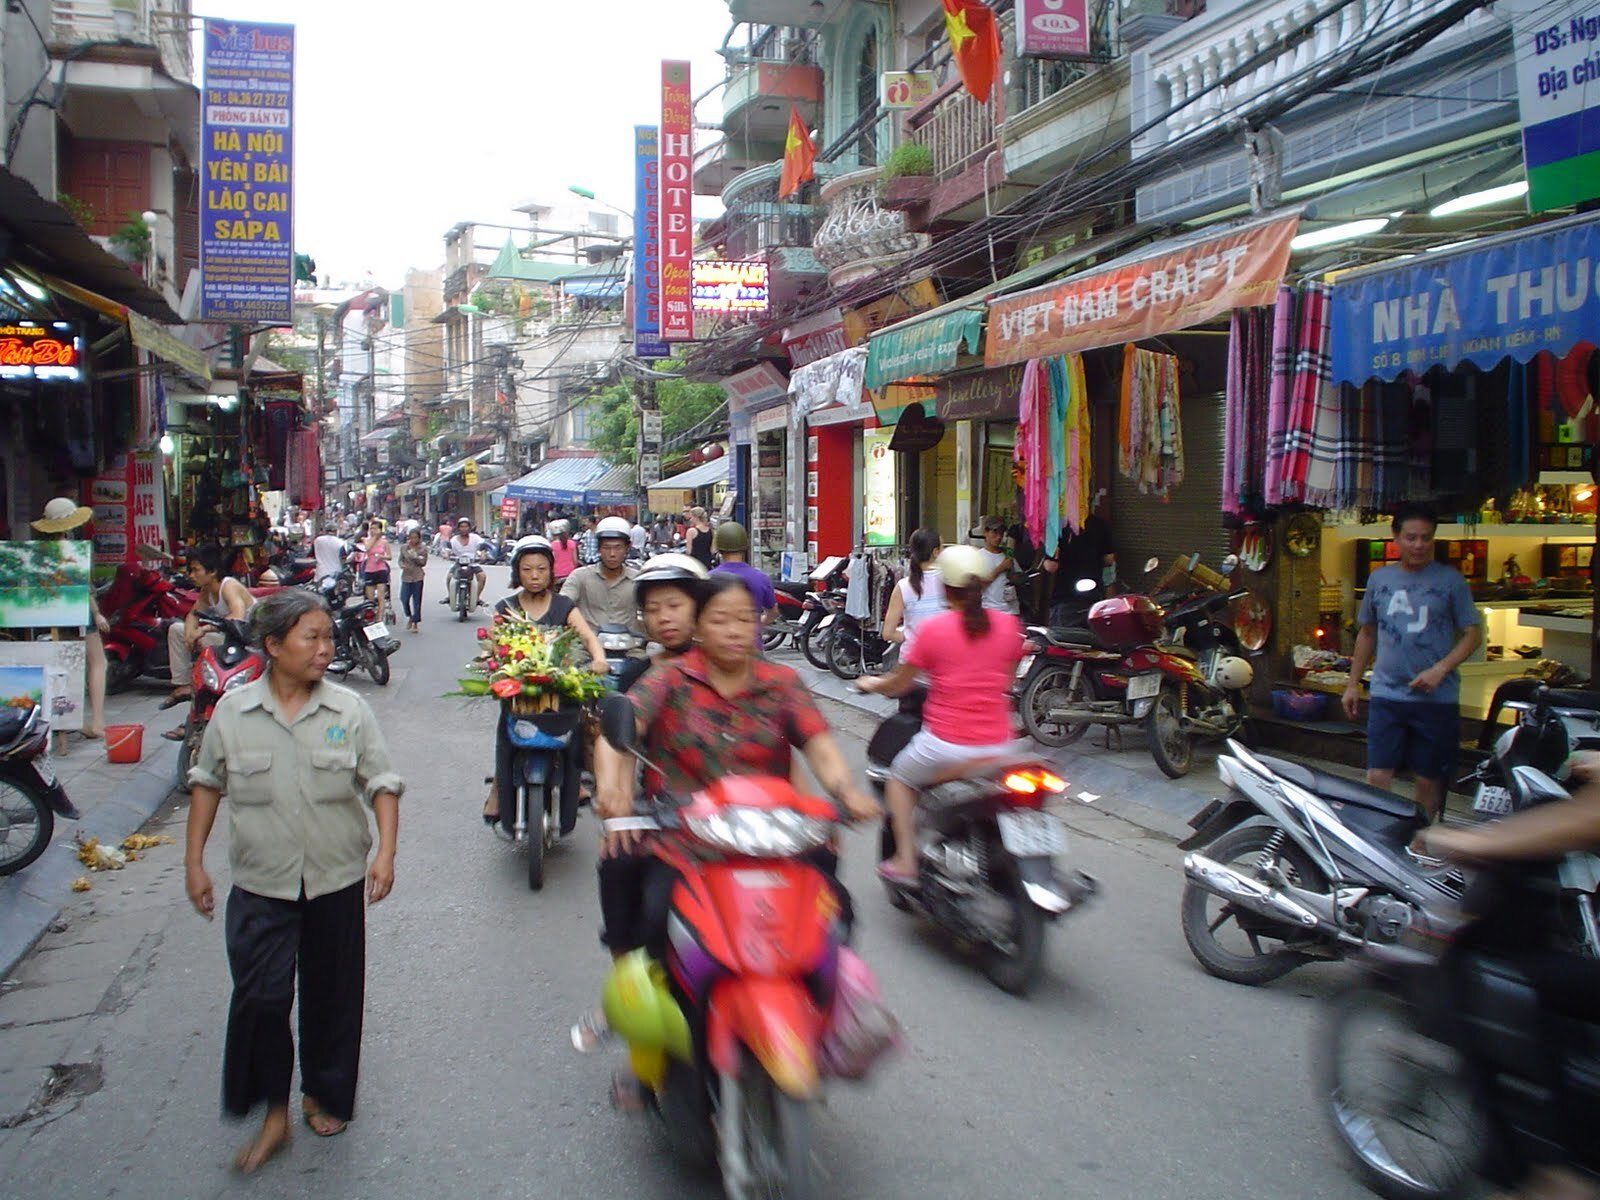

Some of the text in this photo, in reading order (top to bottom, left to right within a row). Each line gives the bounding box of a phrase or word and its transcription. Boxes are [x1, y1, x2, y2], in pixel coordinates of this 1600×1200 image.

[1570, 15, 1600, 43] Ng
[1538, 66, 1568, 100] Địa
[213, 128, 283, 157] HÀ NỘI
[207, 157, 288, 182] YÊN BÁI
[208, 186, 287, 211] LÀO CAI
[663, 133, 690, 257] HOTEL
[214, 219, 280, 240] SAPA
[1063, 284, 1119, 329] NAM
[1129, 244, 1249, 312] CRAFT
[1373, 256, 1600, 344] NHÀ THU
